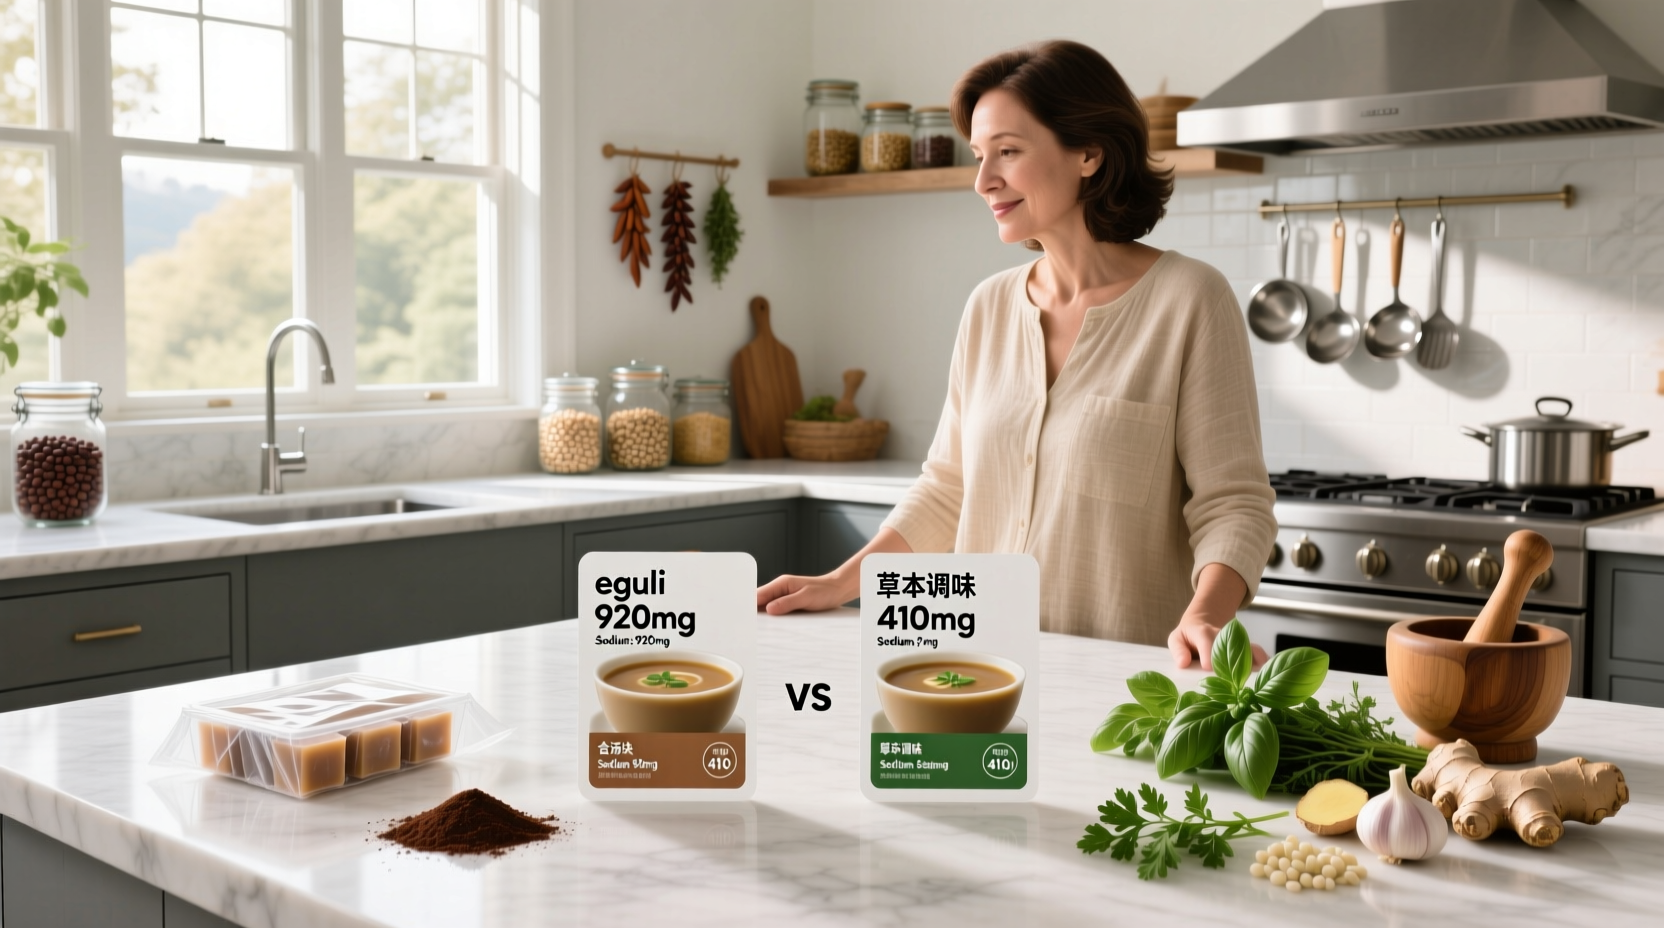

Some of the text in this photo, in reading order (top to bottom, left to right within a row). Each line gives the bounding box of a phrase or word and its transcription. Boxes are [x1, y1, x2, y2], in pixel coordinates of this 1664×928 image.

[594, 569, 666, 602] eguli
[876, 571, 977, 599] 草本调味
[594, 603, 696, 638] 920mg
[877, 604, 976, 639] 410mg
[634, 634, 671, 648] 920mg
[707, 757, 732, 770] 410
